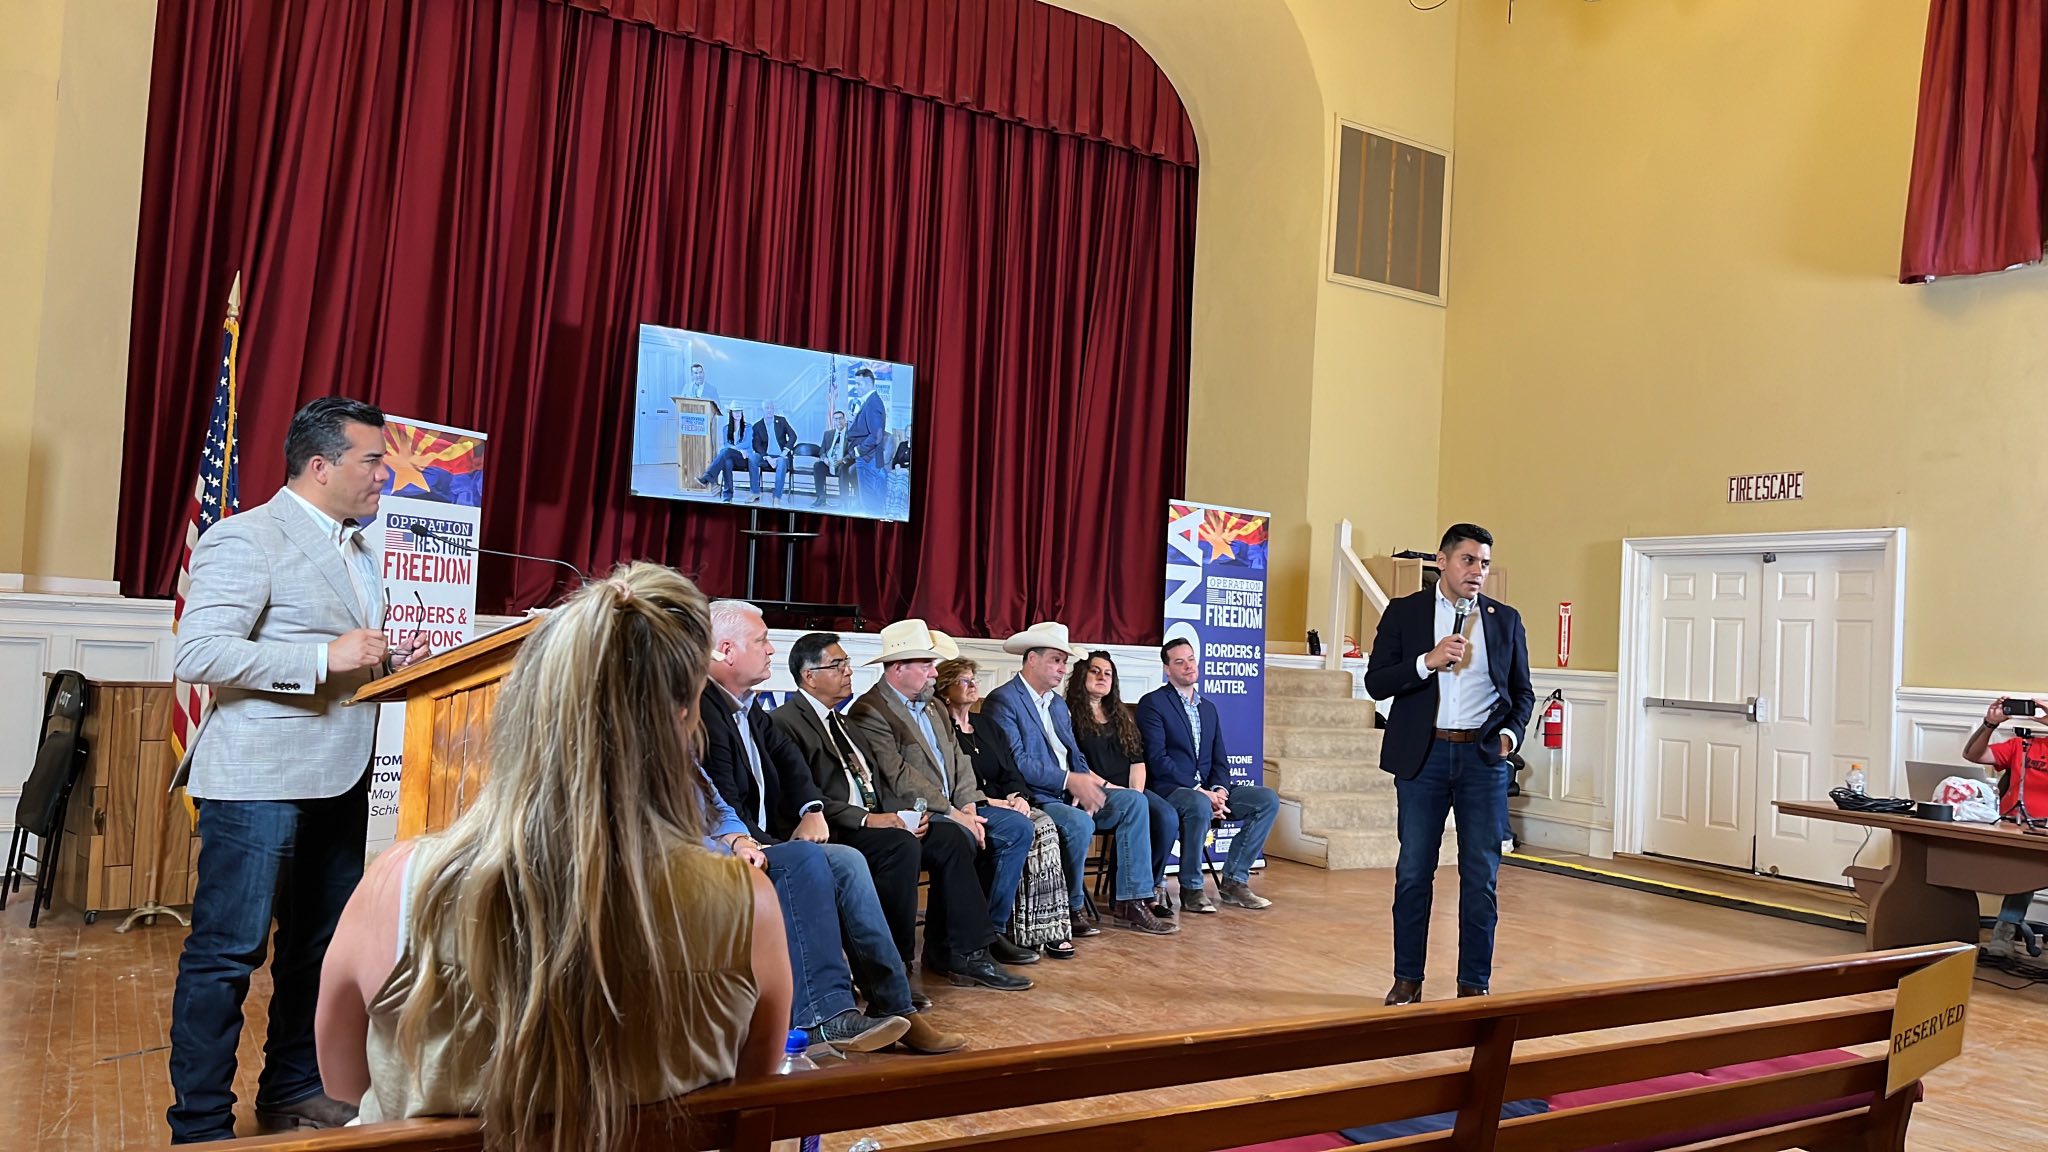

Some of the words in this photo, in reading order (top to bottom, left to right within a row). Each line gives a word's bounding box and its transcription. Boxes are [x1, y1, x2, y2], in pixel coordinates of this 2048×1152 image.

[1729, 476, 1754, 501] FIRE
[1755, 473, 1802, 500] ESCAPE
[415, 534, 472, 556] RESTORE
[383, 551, 471, 585] FREEDOM
[1210, 577, 1261, 591] OPERATION
[1226, 590, 1263, 607] RESTORE
[458, 608, 467, 624] &
[1205, 604, 1263, 629] FREEDOM
[1205, 643, 1253, 659] BORDERS
[1254, 645, 1261, 659] &
[1204, 661, 1259, 677] ELECTIONS
[1204, 679, 1248, 694] MATTER.
[375, 755, 402, 766] TOM
[371, 789, 397, 801] May
[1893, 1004, 1965, 1055] RESERVED
